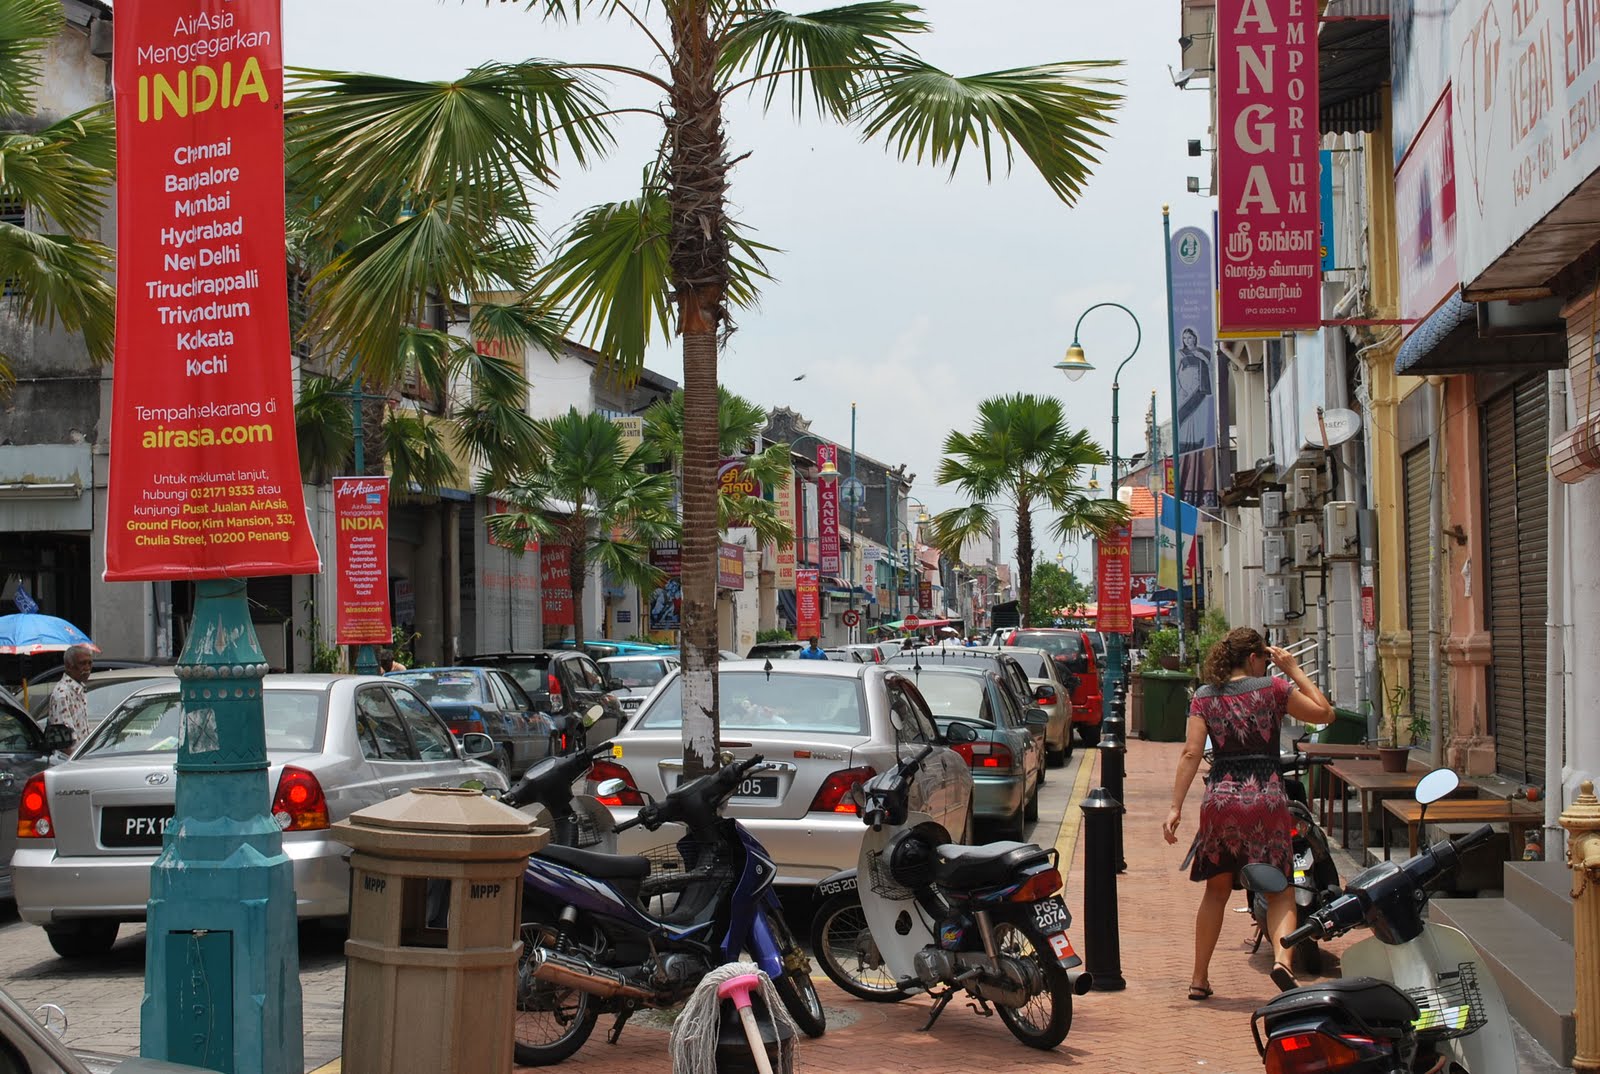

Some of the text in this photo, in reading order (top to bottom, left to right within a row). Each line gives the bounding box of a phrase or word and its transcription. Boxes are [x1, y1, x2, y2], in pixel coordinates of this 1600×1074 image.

[173, 9, 234, 38] AirAsia
[138, 56, 269, 123] INDIA
[1508, 18, 1553, 150] KEDAI
[1561, 79, 1600, 160] LEBU
[160, 215, 243, 249] Hydrabad
[1257, 221, 1314, 253] கங்கா
[199, 243, 241, 267] Delhi
[1225, 262, 1267, 280] மொத்த
[1245, 307, 1258, 316] (PG
[135, 403, 197, 423] Tempah
[265, 397, 277, 414] di
[153, 473, 187, 485] Untuk
[237, 468, 270, 482] lanjut,
[143, 489, 188, 501] hubungi
[228, 485, 255, 497] 9333
[257, 485, 281, 495] atau
[134, 504, 180, 516] kunjungi
[182, 503, 209, 515] Pusat
[211, 501, 247, 513] Jualan
[126, 520, 168, 531] Ground
[202, 518, 224, 529] Kim
[226, 515, 274, 528] Mansion,
[341, 517, 384, 531] INDIA
[135, 534, 170, 546] Chulia
[209, 533, 246, 544] 10200
[821, 543, 838, 551] STORE
[1101, 546, 1129, 556] INDIA
[545, 601, 562, 611] PRICE
[125, 818, 156, 835] PFX
[364, 876, 386, 894] MPPP
[470, 884, 500, 899] MPPP
[820, 881, 841, 896] PGS
[1034, 898, 1059, 916] PGS
[1036, 908, 1067, 928] 2074
